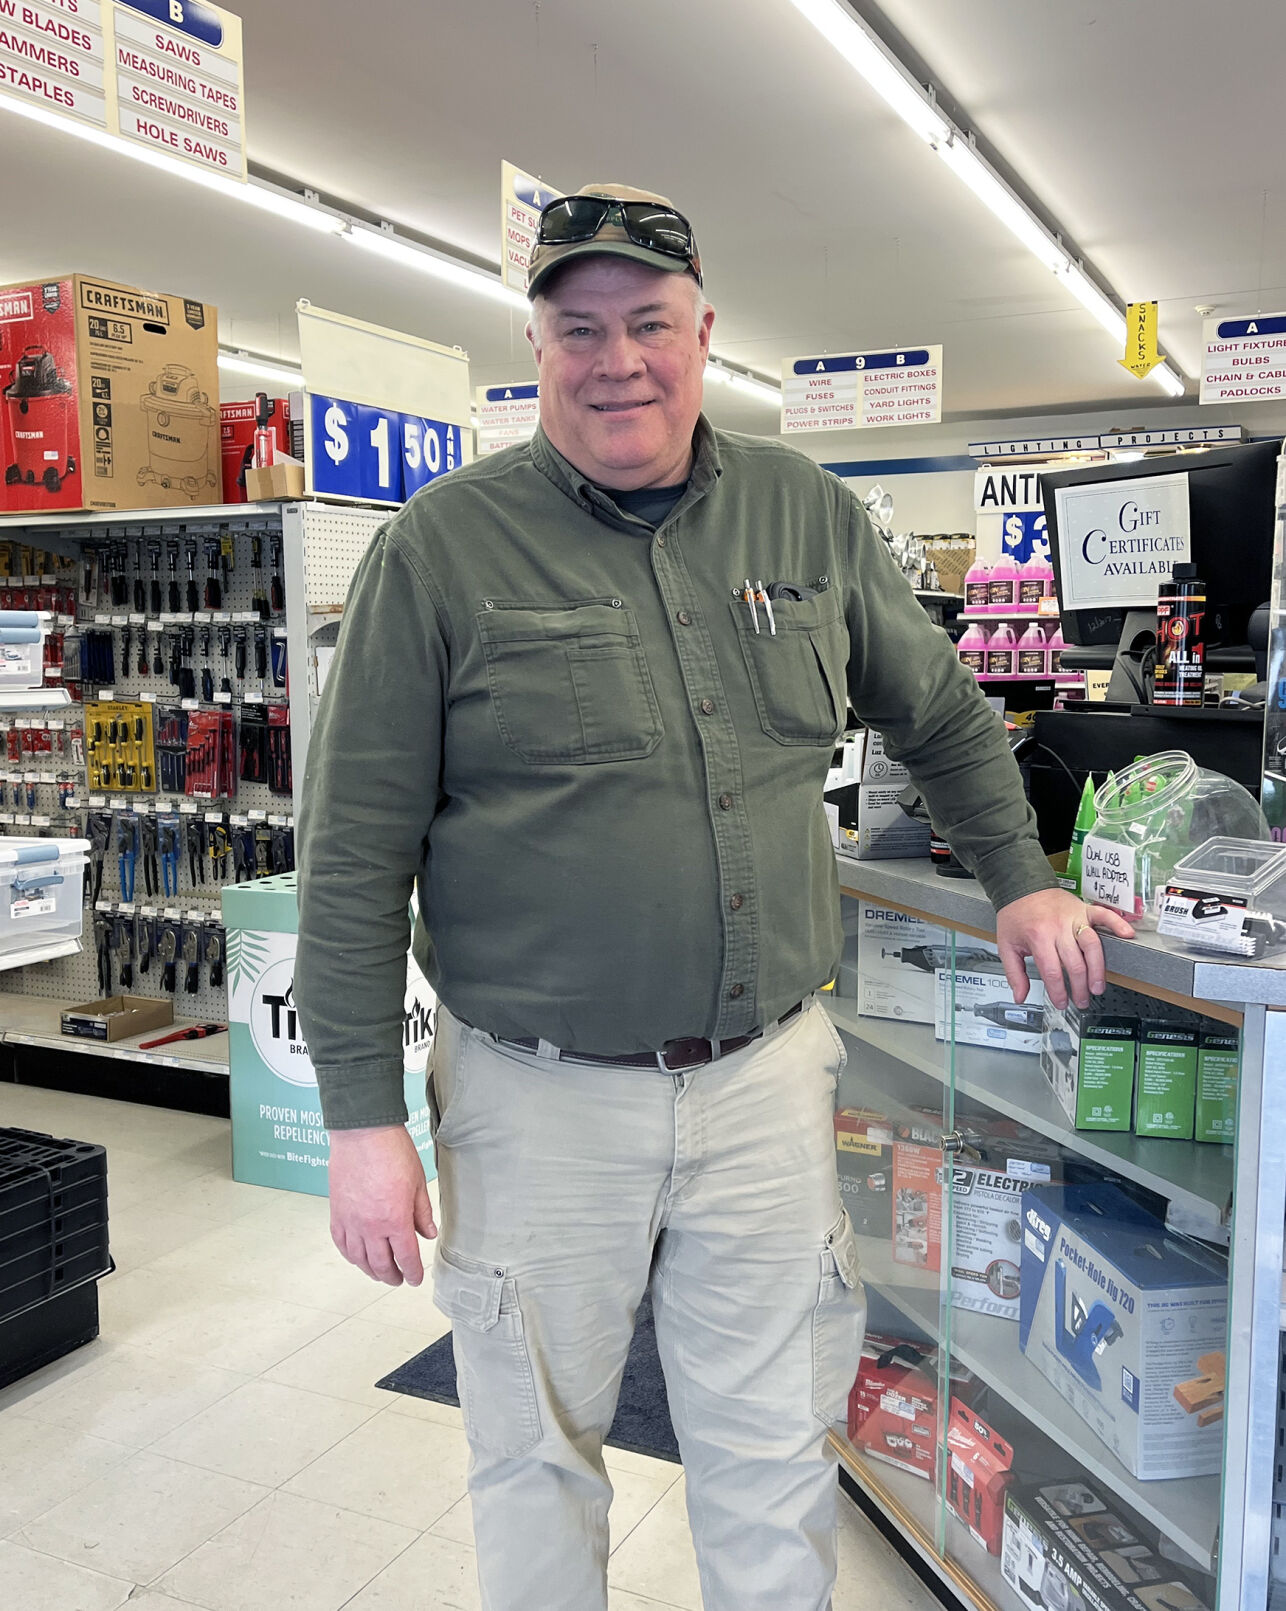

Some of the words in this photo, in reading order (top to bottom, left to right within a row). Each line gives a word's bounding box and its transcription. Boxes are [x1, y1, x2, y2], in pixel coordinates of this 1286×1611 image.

[169, 0, 184, 23] B
[22, 7, 92, 50] BLADES
[0, 31, 80, 77] AMMERS
[155, 34, 201, 66] SAWS
[0, 62, 75, 107] STAPLES
[118, 48, 197, 94] MEASURING
[199, 83, 238, 111] TAPES
[132, 86, 229, 136] SCREWDRIVERS
[136, 118, 179, 148] HOLE
[183, 138, 228, 165] SAWS
[533, 190, 541, 206] A
[512, 207, 526, 223] PET
[508, 228, 531, 248] MOPS
[509, 250, 530, 268] VACU
[86, 290, 164, 318] CRAFTSMAN
[89, 319, 99, 330] 20
[112, 323, 125, 334] 6.5
[1138, 304, 1146, 360] SNACKS
[1246, 322, 1258, 334] A
[1208, 343, 1239, 353] LIGHT
[815, 361, 826, 371] A
[855, 356, 866, 369] 9
[896, 354, 905, 365] B
[1232, 356, 1270, 366] BULBS
[809, 379, 832, 387] WIRE
[864, 372, 905, 382] ELECTRIC
[907, 369, 937, 378] BOXES
[1206, 373, 1242, 383] CHAIN
[1246, 372, 1253, 380] &
[1258, 369, 1286, 379] CABL
[504, 389, 513, 398] A
[806, 392, 835, 400] FUSES
[864, 387, 899, 396] CONDUIT
[902, 383, 936, 392] FITTINGS
[1220, 386, 1281, 397] PADLOCKS
[481, 405, 508, 413] WATER
[510, 403, 537, 411] PUMPS
[785, 407, 808, 415] PLUGS
[818, 404, 854, 413] SWITCHES
[870, 401, 895, 409] YARD
[898, 398, 931, 407] LIGHTS
[482, 417, 509, 425] WATER
[786, 420, 819, 428] POWER
[822, 417, 853, 426] STRIPS
[867, 414, 895, 423] WORK
[897, 412, 931, 421] LIGHTS
[324, 402, 349, 465] $
[370, 418, 390, 488] 1
[404, 423, 440, 473] 50
[984, 440, 1082, 454] LIGHTING
[1118, 430, 1224, 445] PROJECTS
[981, 473, 1041, 507] ANTI
[1119, 501, 1160, 532] GIFT
[1004, 515, 1023, 548] $
[1082, 529, 1184, 564] CERTIFICATES
[1104, 561, 1178, 576] AVAILABL
[1156, 612, 1205, 643] HOT
[1169, 651, 1190, 664] ALL
[1105, 852, 1120, 867] USB
[1086, 865, 1101, 878] WALL
[1164, 904, 1189, 915] BRUSH
[414, 1040, 431, 1053] BRAND
[260, 1104, 297, 1123] PROVEN
[274, 1124, 330, 1147] REPELLENCY
[842, 1138, 878, 1151] WAGNER
[953, 1171, 968, 1185] 2
[952, 1185, 968, 1193] PEED
[974, 1190, 995, 1200] PISTOLA
[1002, 1195, 1020, 1203] CALOR
[1060, 1237, 1106, 1290] Pocket-Hole
[1106, 1278, 1119, 1302] Jig
[1119, 1288, 1135, 1314] 720
[1051, 1548, 1064, 1568] 3.5
[1064, 1563, 1082, 1587] AMP
